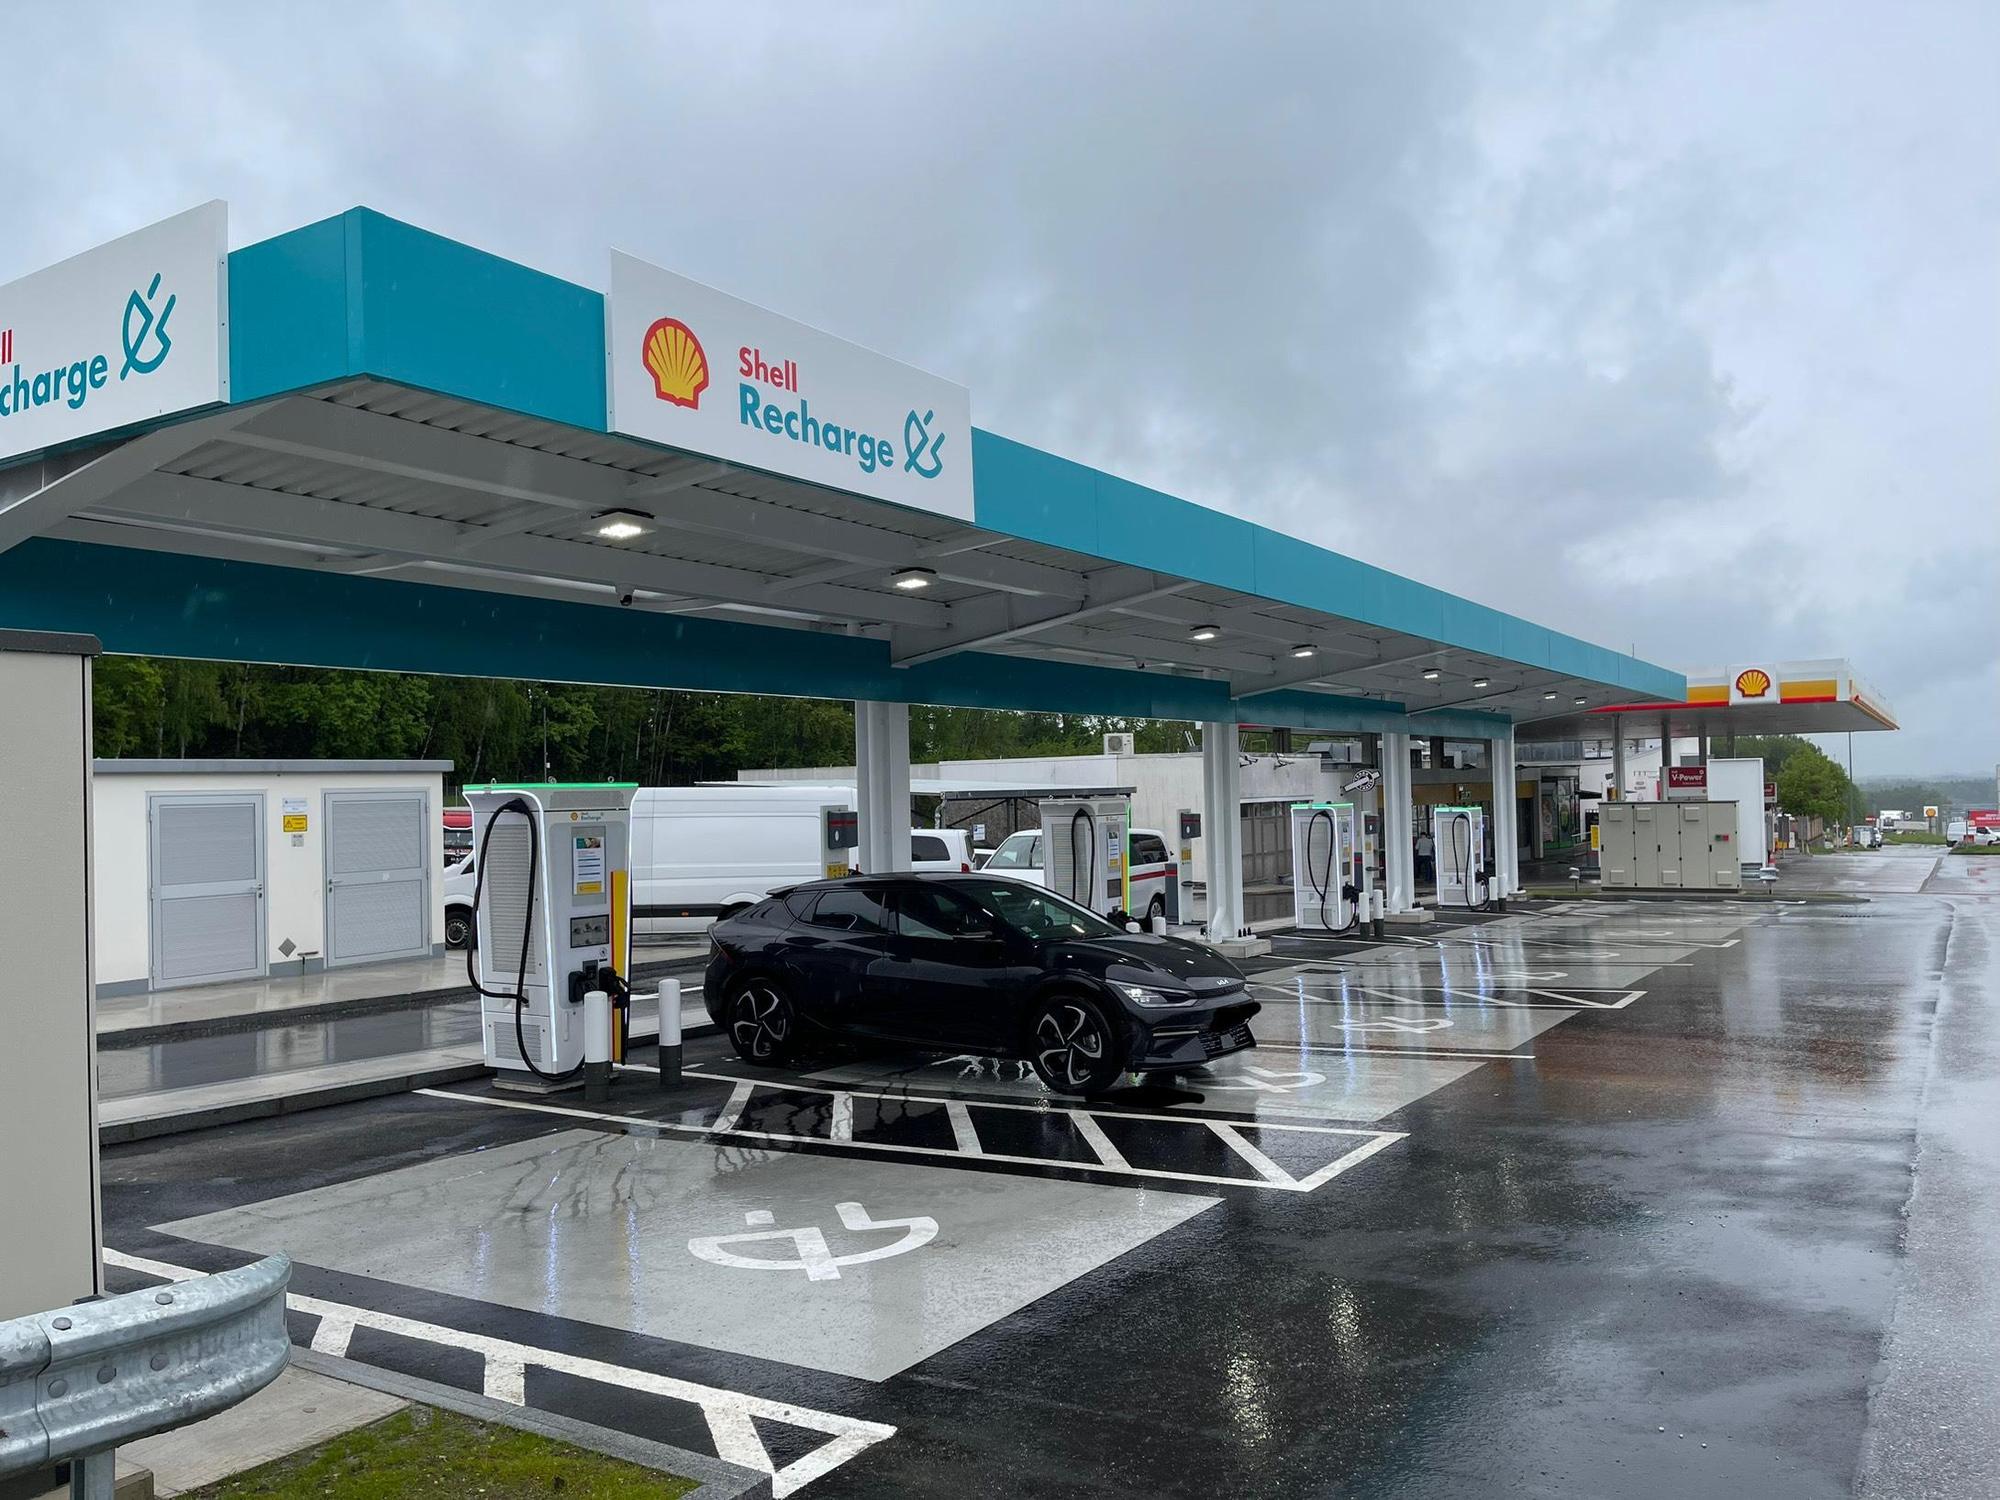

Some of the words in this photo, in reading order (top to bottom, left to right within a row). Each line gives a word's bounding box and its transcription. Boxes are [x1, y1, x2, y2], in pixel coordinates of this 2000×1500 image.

[0, 355, 108, 417] charge
[738, 347, 798, 393] Shell
[739, 382, 894, 474] Recharge
[1671, 774, 1703, 782] V-Power
